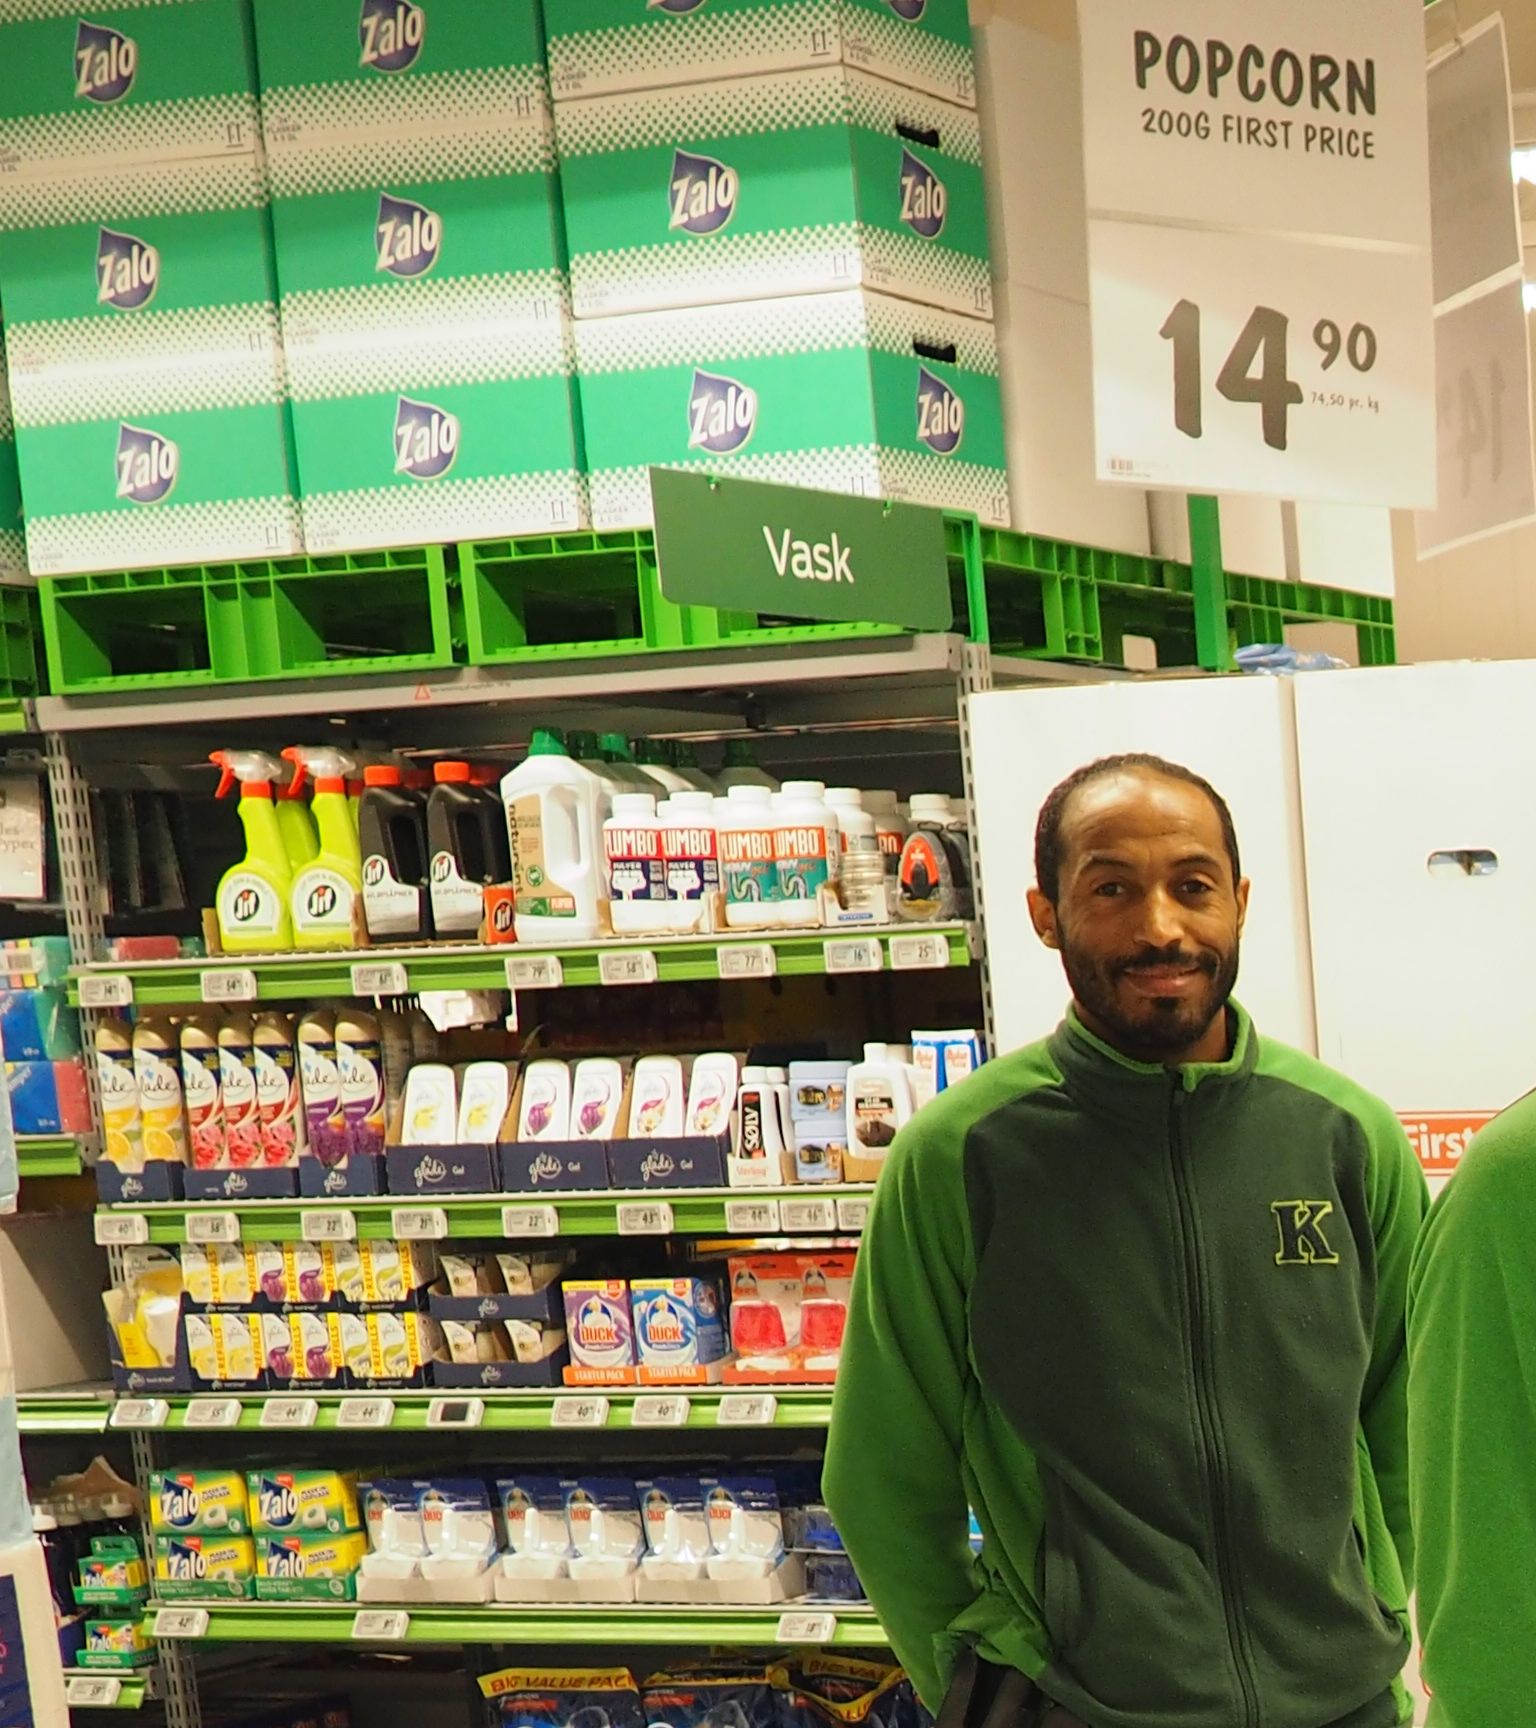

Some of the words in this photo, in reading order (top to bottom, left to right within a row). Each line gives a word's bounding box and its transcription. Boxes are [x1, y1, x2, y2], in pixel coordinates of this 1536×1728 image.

[360, 0, 425, 67] Zalo
[75, 37, 137, 98] Zalo
[1133, 29, 1377, 117] POPCORN
[1141, 108, 1211, 140] 200G
[1223, 116, 1292, 151] FIRST
[1304, 123, 1375, 159] PRICE
[669, 161, 738, 231] Zalo
[900, 167, 946, 230] Zalo
[376, 211, 440, 270] Zalo
[98, 245, 158, 304] Zalo
[1158, 298, 1304, 451] 14
[1311, 319, 1378, 374] 90
[394, 408, 459, 476] Zalo
[687, 381, 756, 451] Zalo
[916, 386, 964, 445] Zalo
[117, 439, 178, 498] Zalo
[763, 527, 855, 584] Vask
[1271, 1200, 1338, 1265] K
[162, 1490, 199, 1521] Zalo
[261, 1489, 298, 1521] Zalo
[168, 1552, 206, 1580] Zalo
[268, 1552, 306, 1579] Zalo
